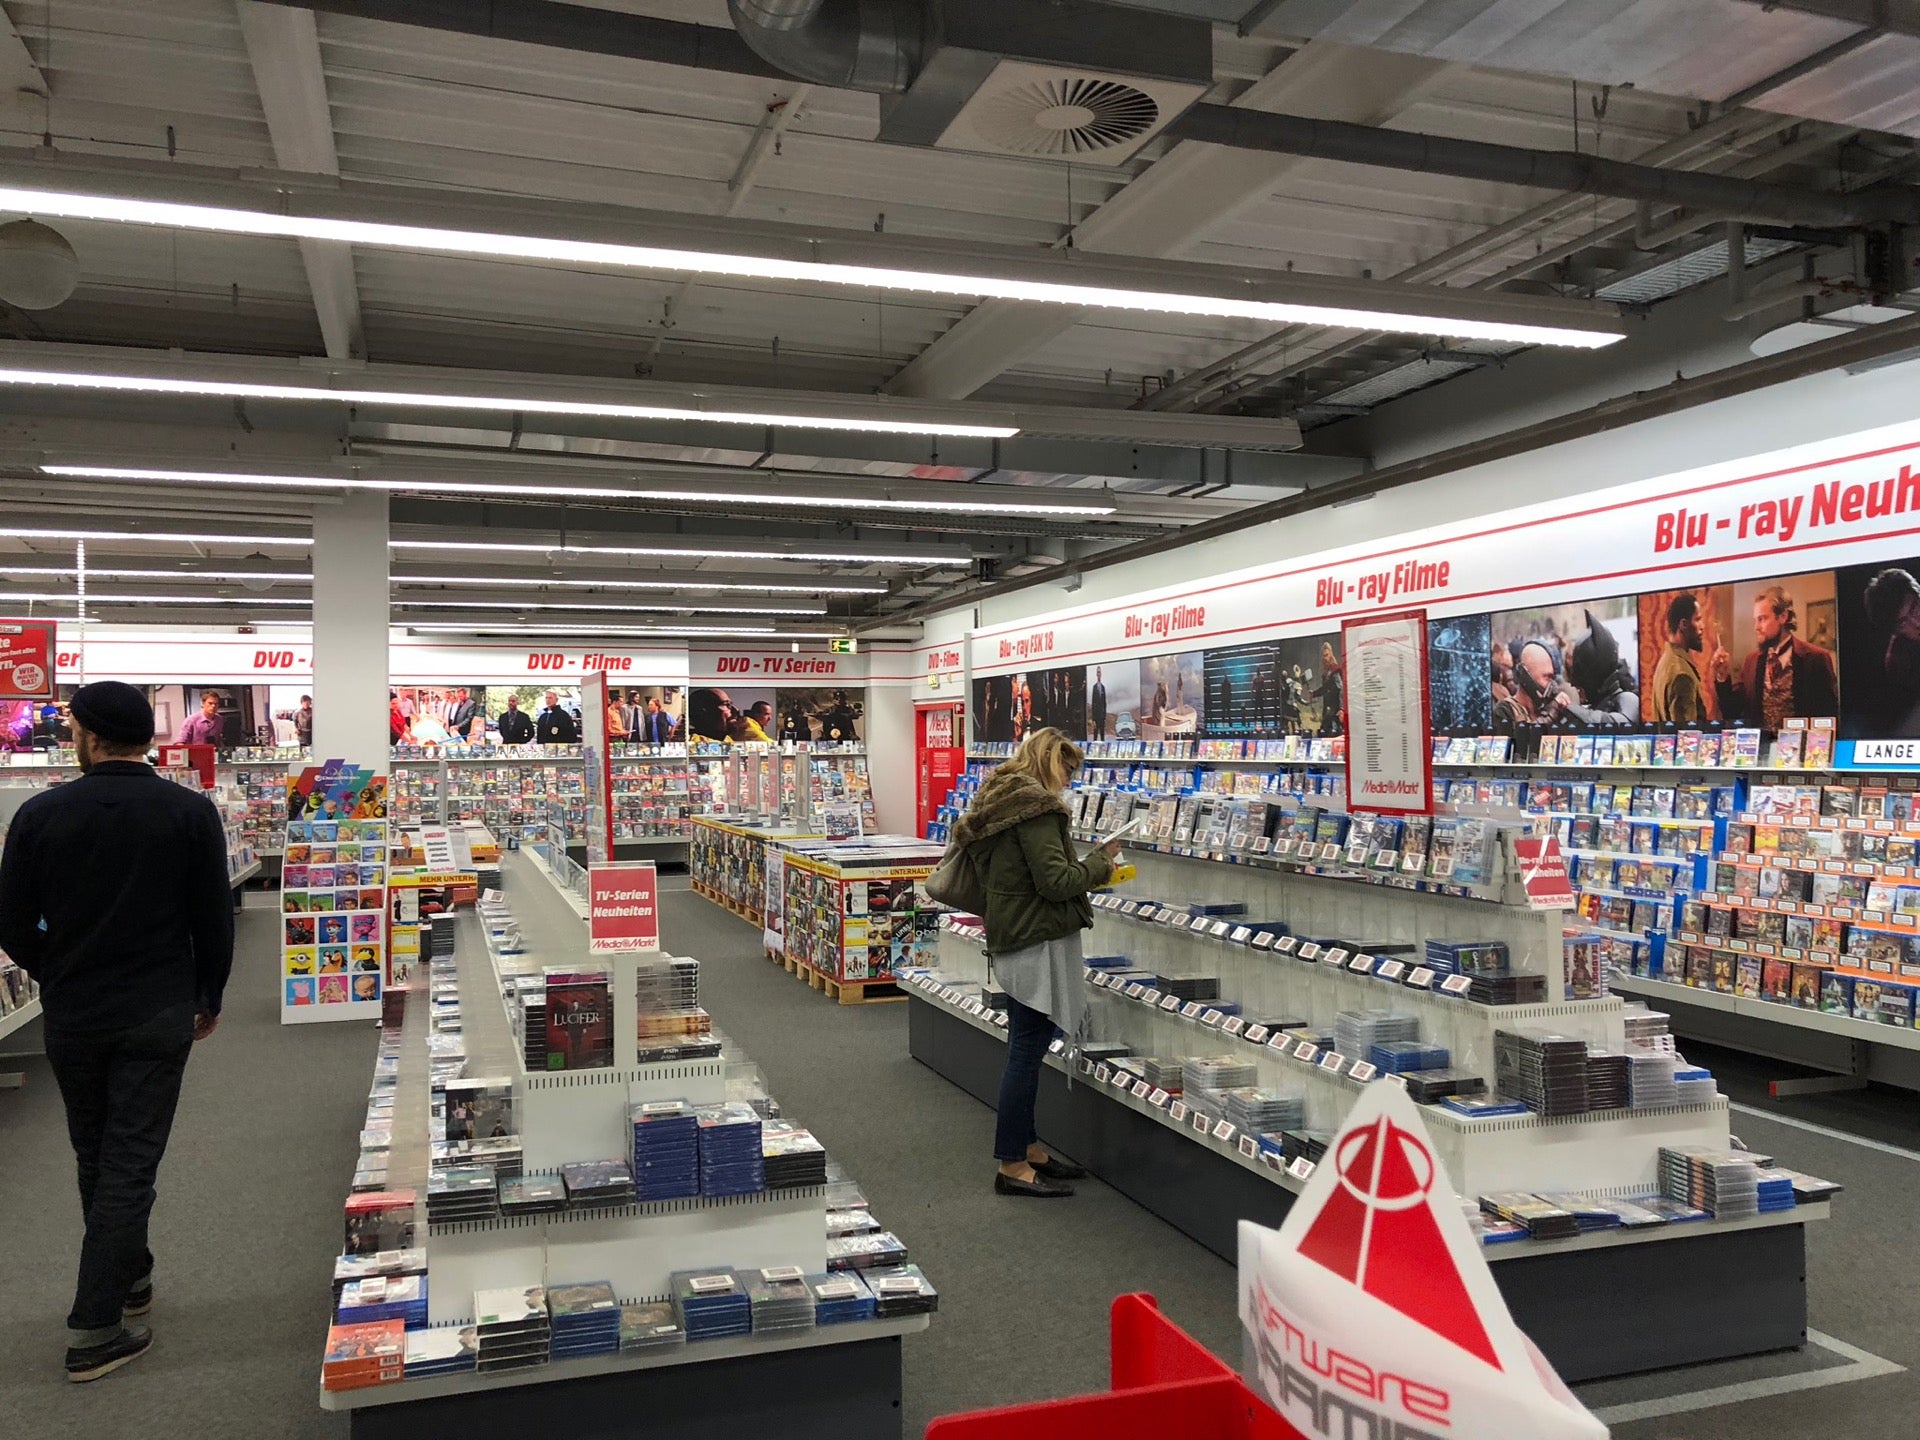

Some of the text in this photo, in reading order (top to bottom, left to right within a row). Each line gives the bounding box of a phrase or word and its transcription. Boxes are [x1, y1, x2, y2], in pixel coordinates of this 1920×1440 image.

[1654, 508, 1709, 552] Blu
[1738, 495, 1804, 542] ray
[1316, 576, 1344, 607] Blu
[1358, 572, 1391, 603] ray
[1393, 560, 1450, 594] Filme
[1125, 614, 1142, 638] Blu
[1151, 612, 1170, 637] ray
[1171, 605, 1205, 631] Filme
[999, 640, 1011, 658] Blu
[1016, 638, 1030, 658] ray
[1030, 634, 1043, 654] FSK
[1044, 631, 1054, 651] 18
[56, 652, 81, 667] er
[253, 651, 294, 668] DVD
[527, 653, 564, 670] DVD
[582, 652, 632, 670] Filme
[716, 657, 750, 673] DVD
[763, 657, 784, 673] TV
[785, 657, 836, 673] Serien
[928, 653, 939, 669] DVD
[943, 650, 959, 667] Filme
[1865, 744, 1914, 759] LANGE
[596, 889, 649, 901] TV-Serien
[592, 906, 653, 917] Neuheiten
[554, 1012, 600, 1027] LUCIFER
